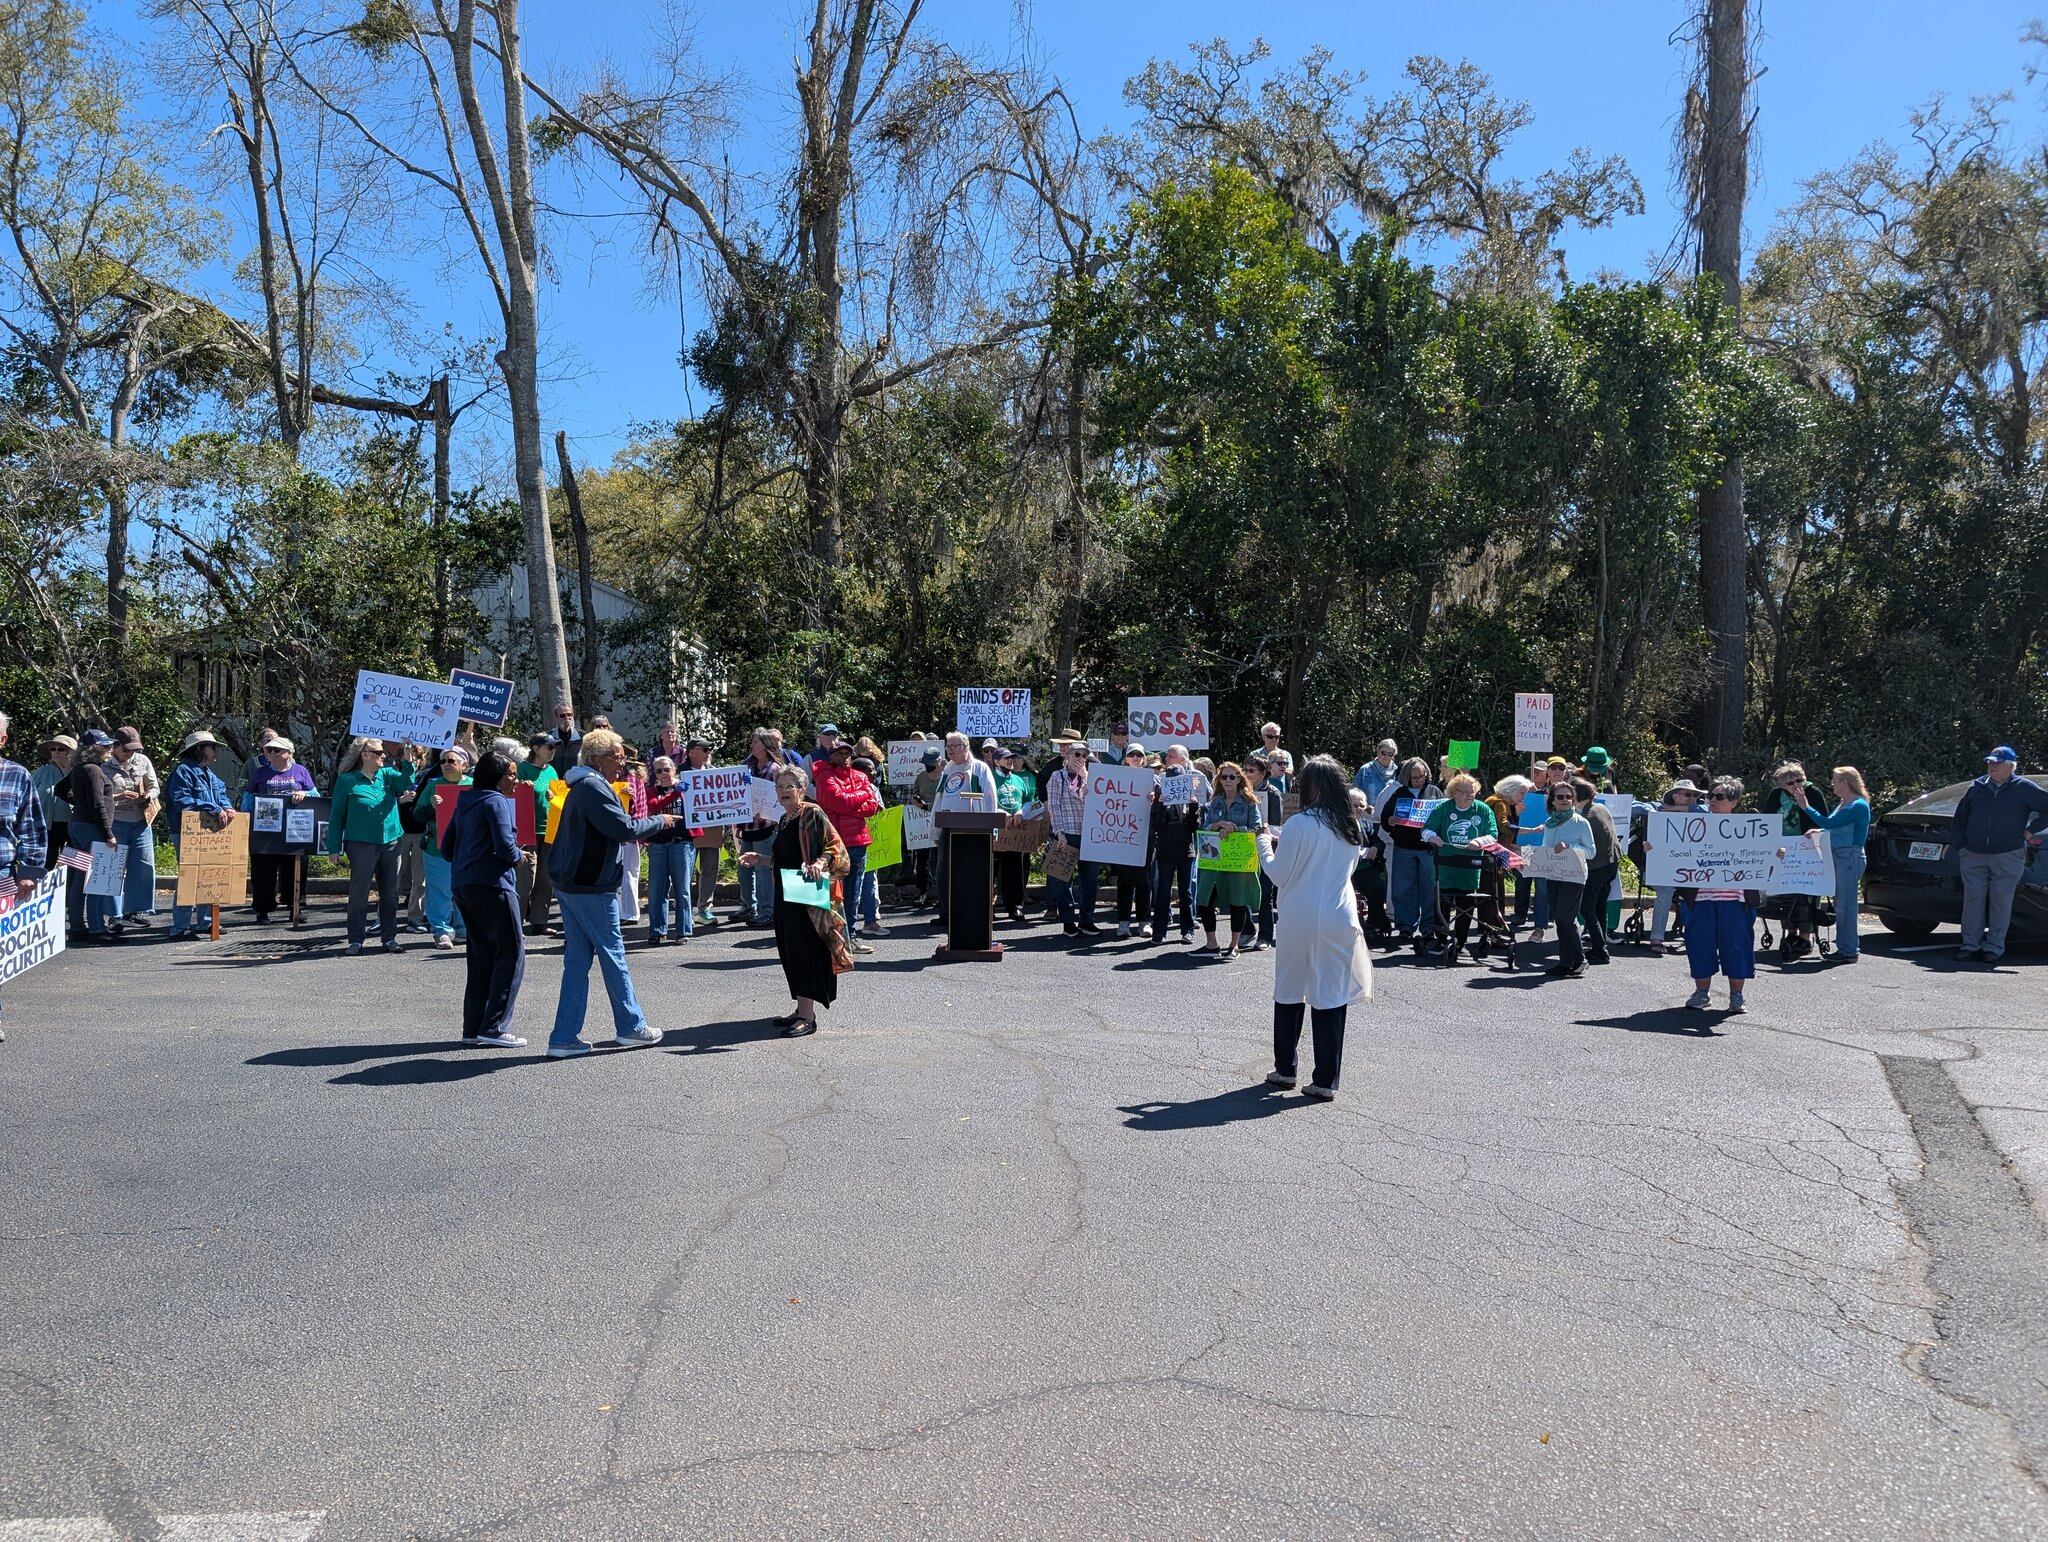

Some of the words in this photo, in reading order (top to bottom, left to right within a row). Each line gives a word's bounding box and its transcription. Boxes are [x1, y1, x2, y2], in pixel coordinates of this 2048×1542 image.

[364, 678, 403, 699] SOCIAL
[409, 686, 457, 707] SECURITY
[459, 678, 487, 691] Speak
[489, 685, 504, 695] Up!
[461, 691, 480, 702] ave
[482, 696, 499, 706] Our
[960, 689, 998, 704] HANDS
[1002, 689, 1030, 706] OFF!
[1516, 697, 1521, 708] I
[1526, 698, 1551, 710] PAID
[388, 698, 397, 708] IS
[404, 702, 422, 712] OUR
[459, 704, 500, 720] mocracy
[960, 705, 986, 716] SOCIAL
[988, 704, 1028, 716] SECURITY
[369, 704, 435, 729] SECURITY
[966, 714, 1018, 726] MEDICARE
[965, 724, 1019, 736] MEDICAID
[1129, 710, 1206, 738] SOSSA
[1517, 720, 1548, 730] SOCIAL
[356, 724, 385, 737] LEAVE
[392, 730, 401, 738] IT
[408, 730, 452, 746] ALONE!
[1516, 731, 1552, 740] SECURITY
[1094, 776, 1140, 798] CALL
[1164, 778, 1189, 788] KEEP
[693, 789, 746, 807] ALREADY
[1169, 787, 1190, 795] SSA
[1104, 798, 1129, 811] OFF
[1412, 800, 1424, 809] NO
[692, 812, 700, 824] R
[706, 811, 714, 820] U
[736, 808, 750, 816] Yet?
[907, 807, 930, 820] HAND
[1096, 810, 1138, 830] YOUR
[1410, 809, 1431, 818] SECU
[190, 836, 232, 846] OUTRAGED
[1670, 849, 1692, 858] Social
[1698, 849, 1736, 861] Security
[1734, 858, 1765, 866] Benefits
[24, 868, 66, 902] TEAL
[0, 895, 55, 938] ROTECT
[0, 935, 56, 982] CURITY
